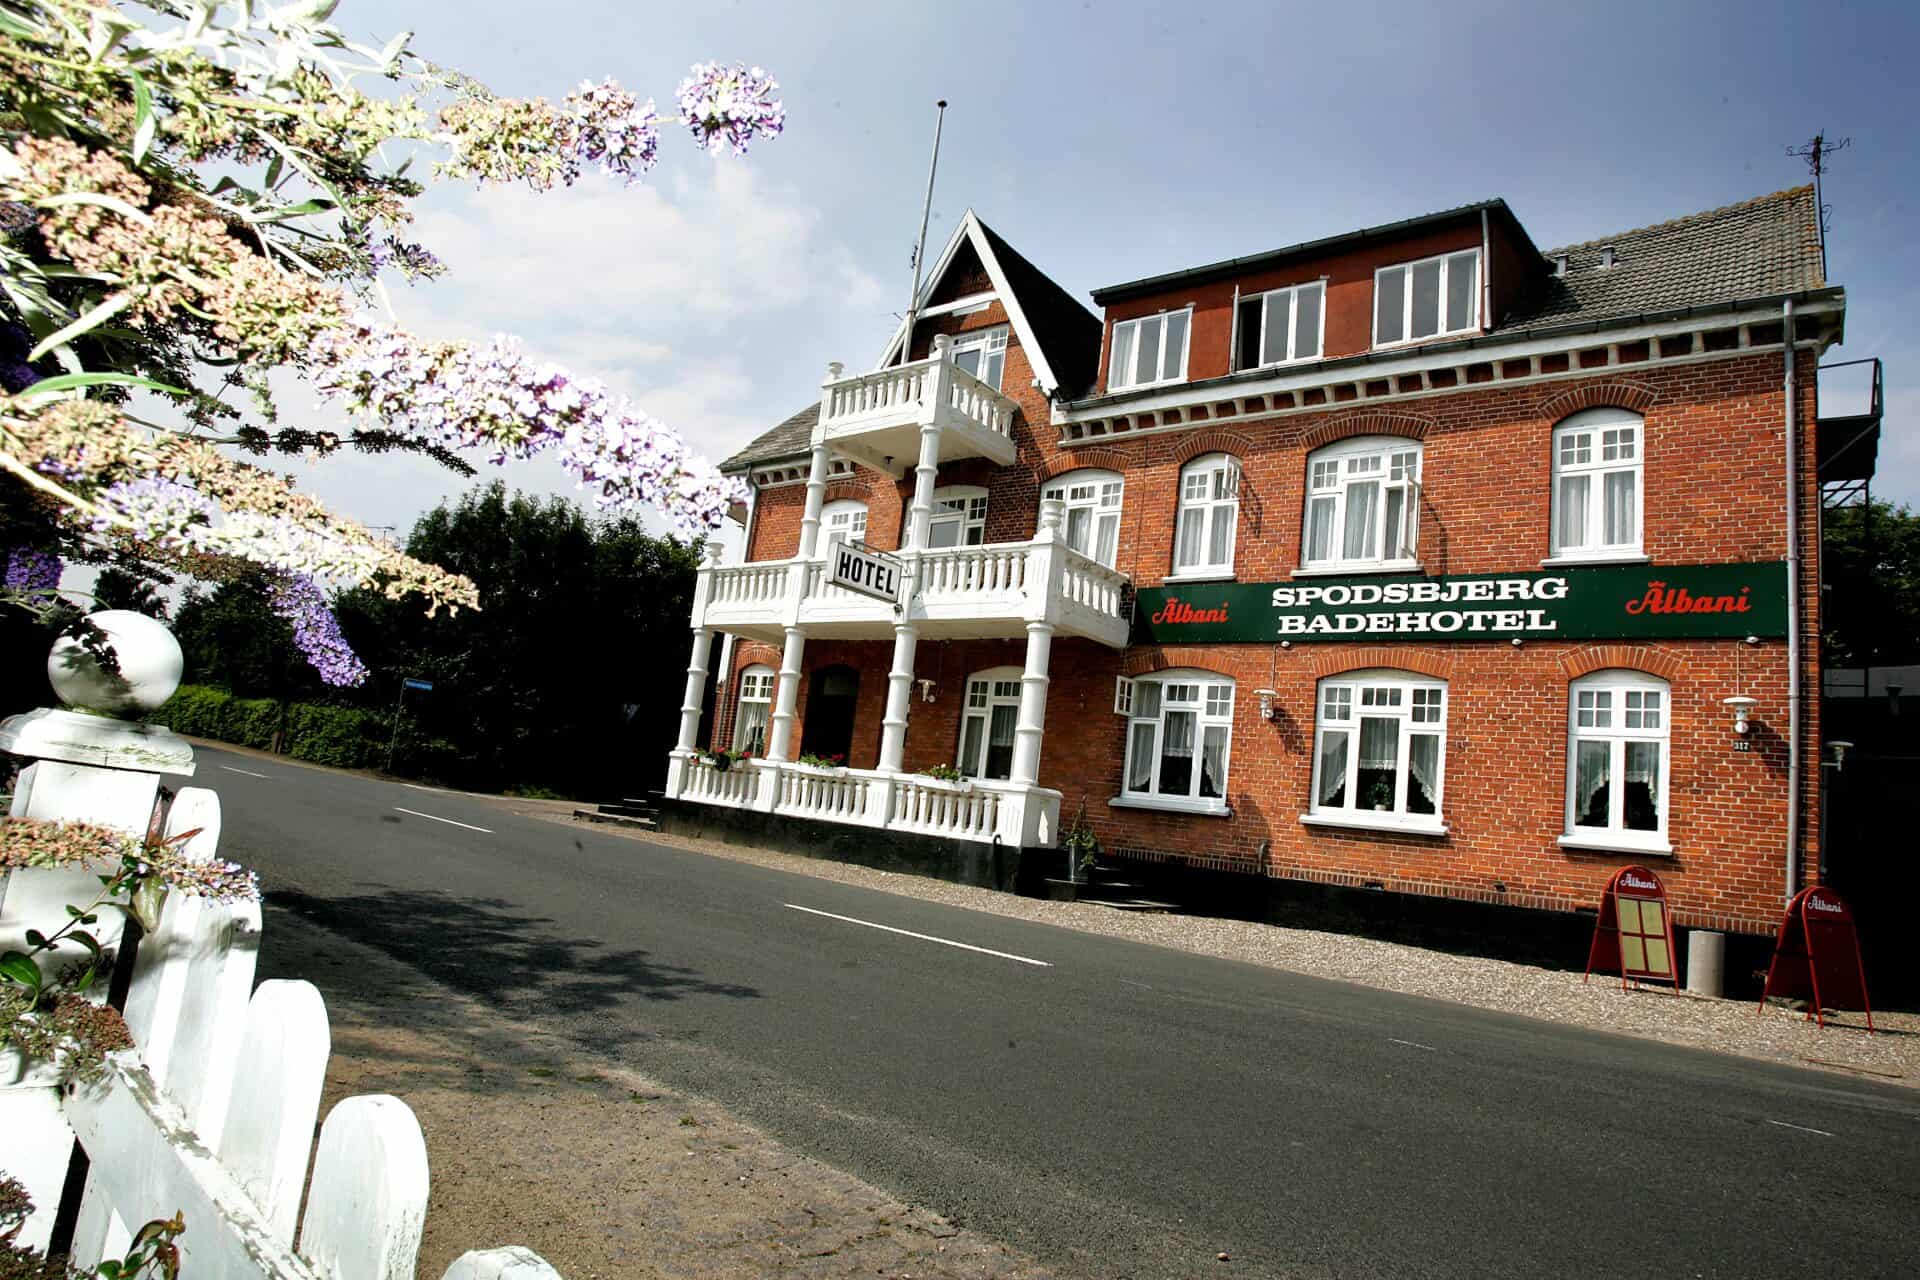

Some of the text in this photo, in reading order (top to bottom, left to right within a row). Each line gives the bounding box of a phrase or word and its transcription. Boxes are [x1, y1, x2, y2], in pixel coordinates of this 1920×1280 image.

[838, 552, 895, 595] HOTEL
[1271, 577, 1569, 607] SPODSBJERG
[1277, 609, 1558, 634] BADEHOTEL
